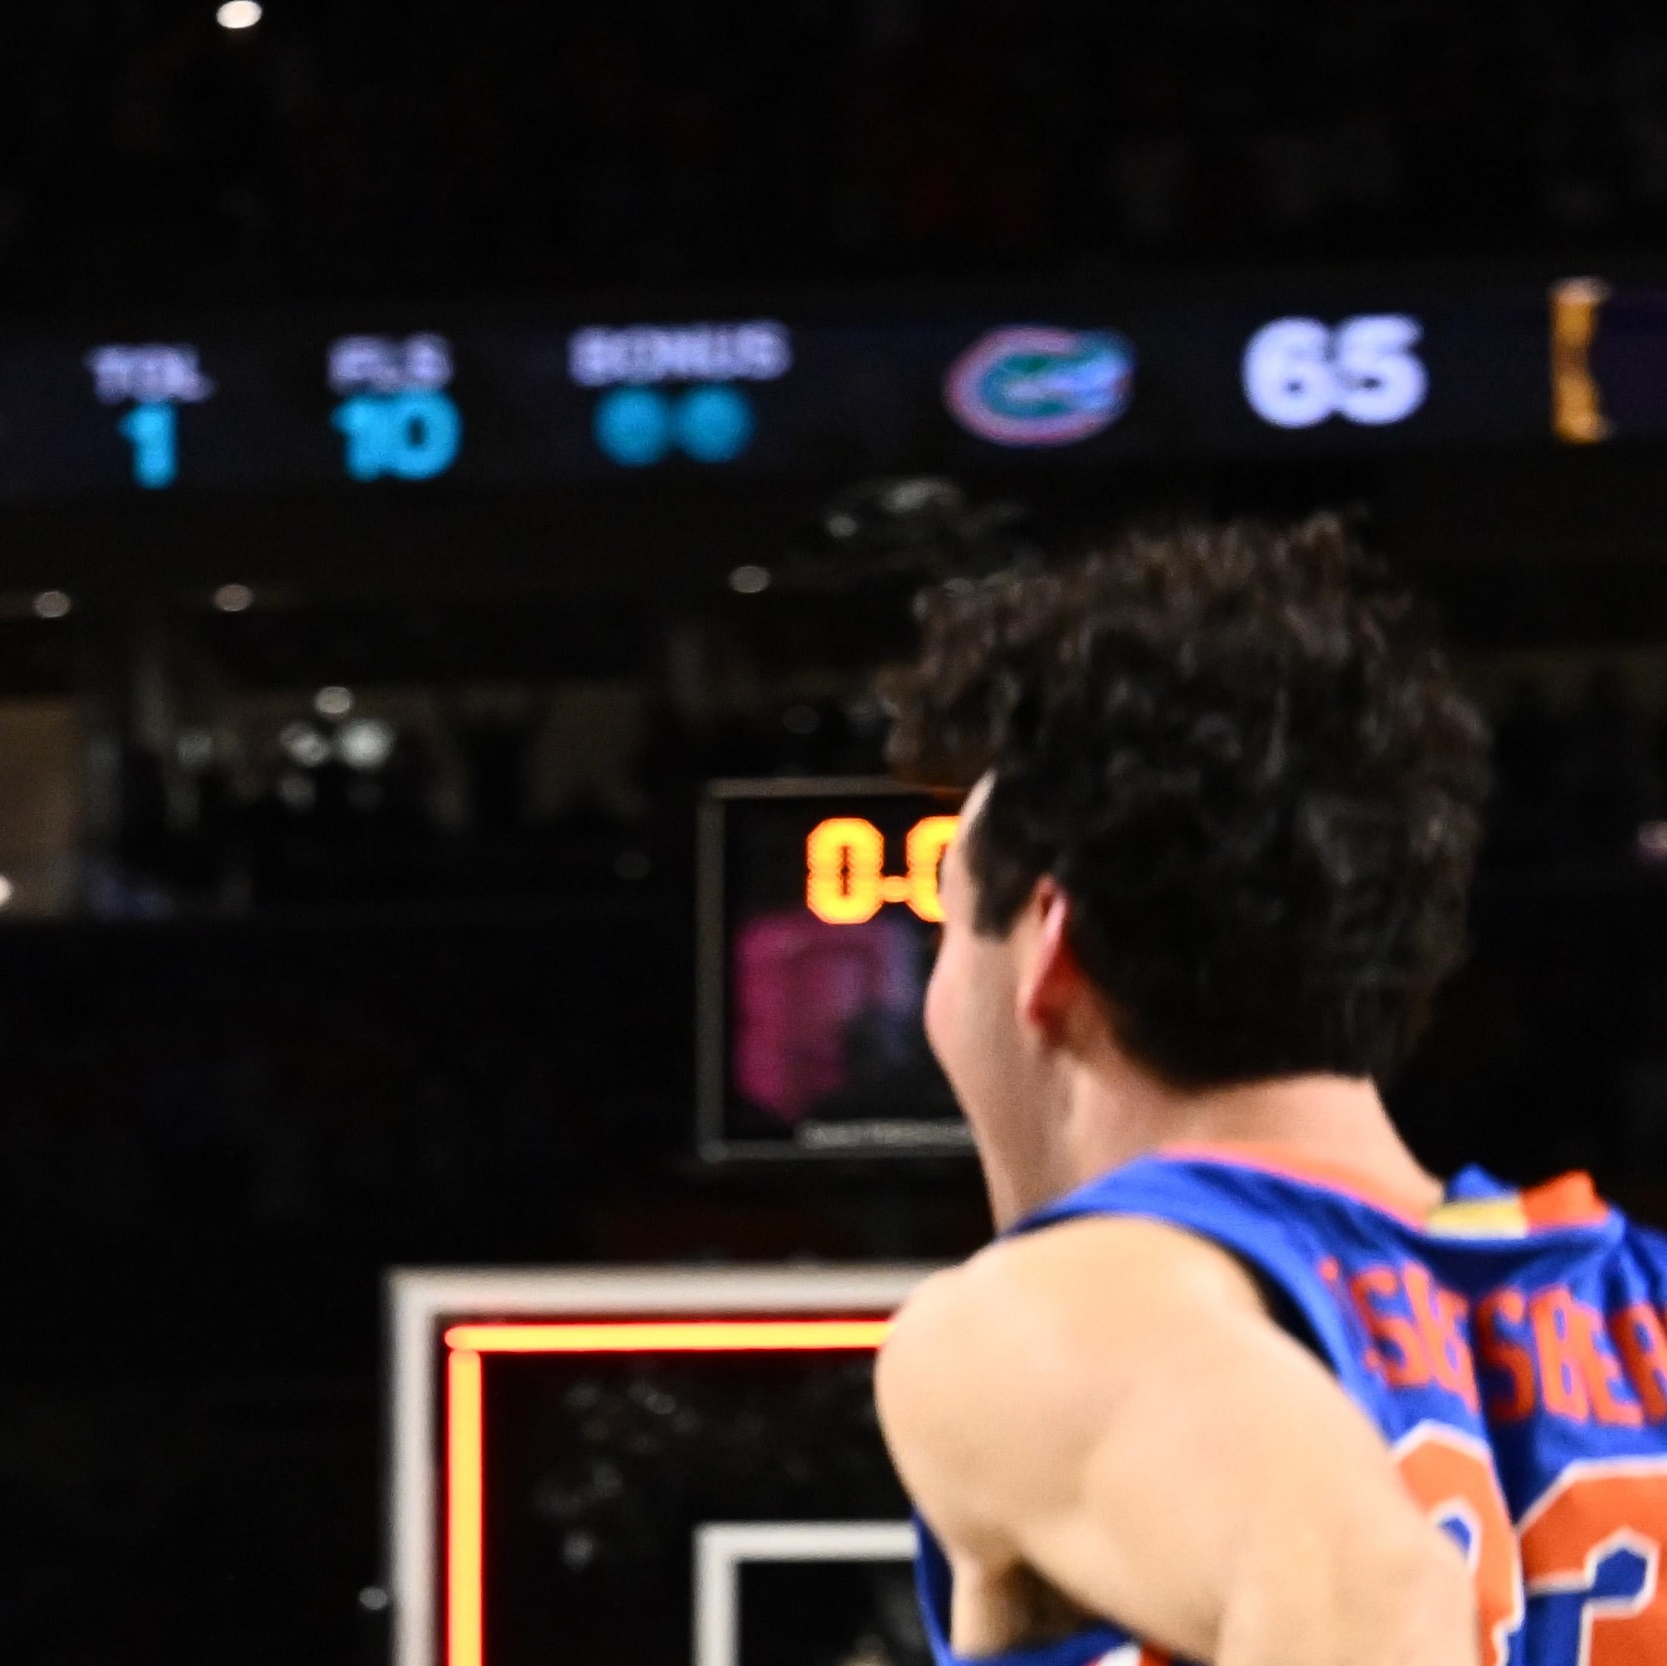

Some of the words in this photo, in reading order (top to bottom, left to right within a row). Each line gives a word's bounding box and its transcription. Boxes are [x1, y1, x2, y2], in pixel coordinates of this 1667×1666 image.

[569, 322, 792, 386] BONUS
[1243, 313, 1429, 430] 65
[120, 402, 178, 488] 1
[331, 390, 460, 480] 10
